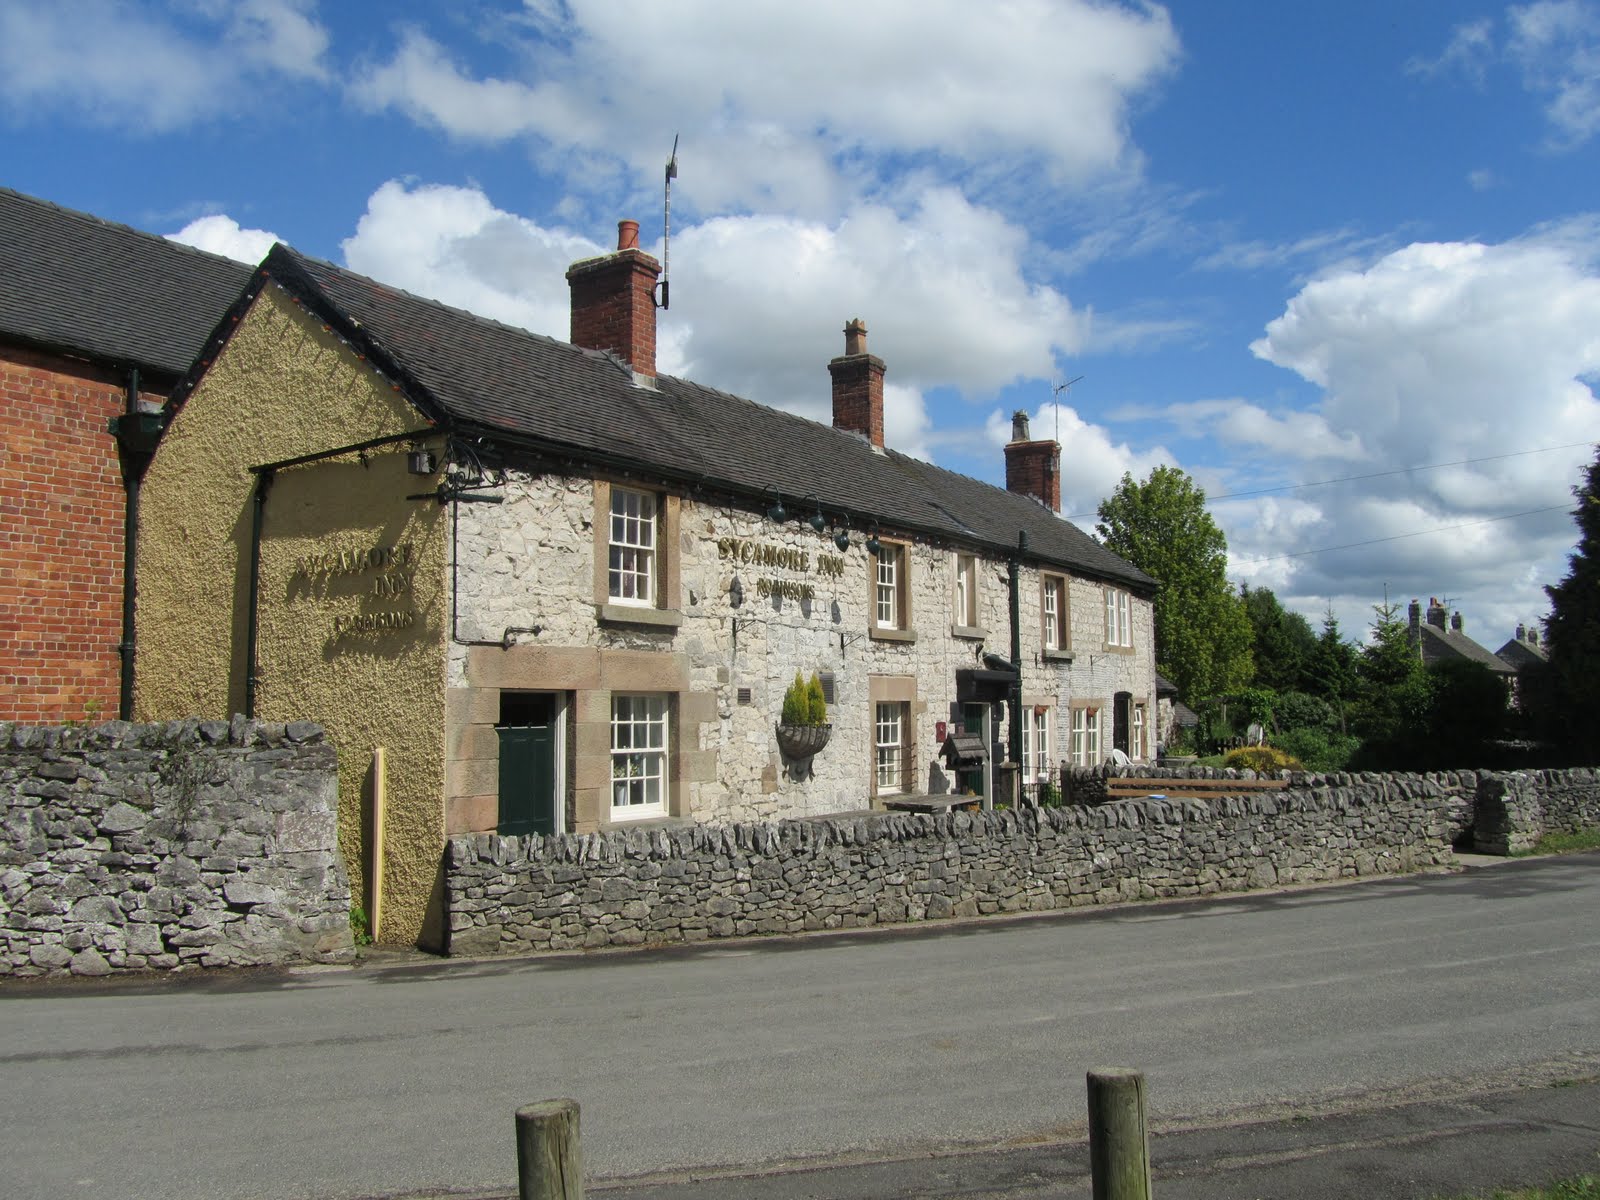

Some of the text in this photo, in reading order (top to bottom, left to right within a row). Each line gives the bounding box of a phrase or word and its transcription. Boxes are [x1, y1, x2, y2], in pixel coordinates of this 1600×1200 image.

[296, 544, 411, 572] SYCAMORE
[718, 537, 844, 576] SYCAMORE INN
[375, 572, 410, 595] INN
[756, 578, 815, 601] ROBINSONS
